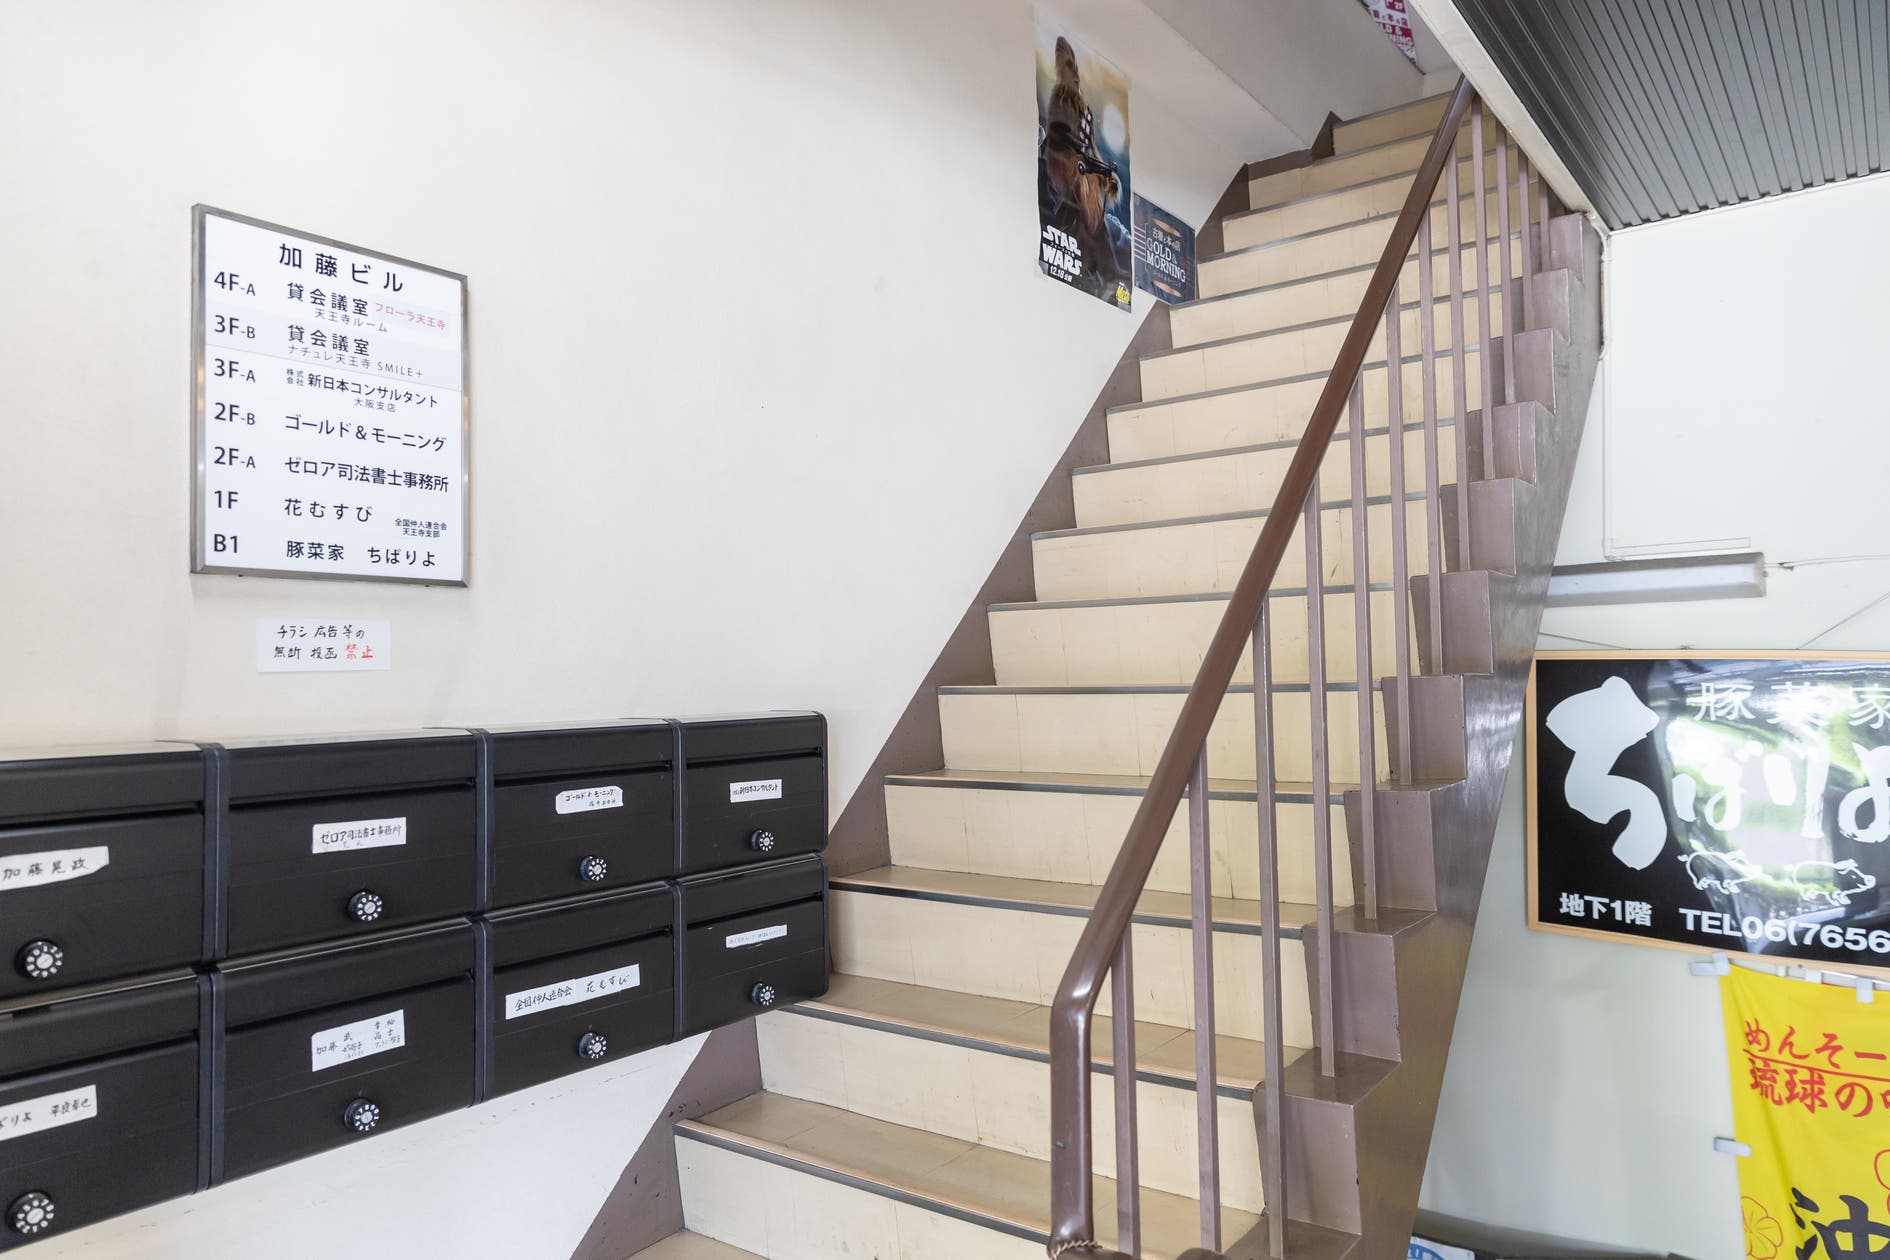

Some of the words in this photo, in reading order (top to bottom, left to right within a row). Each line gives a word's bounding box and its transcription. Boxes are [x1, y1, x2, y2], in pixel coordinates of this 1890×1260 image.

[1043, 224, 1081, 256] STAR
[1146, 237, 1171, 260] GOLD
[279, 243, 403, 292] 加藤ビル
[1042, 243, 1082, 275] WARS
[1146, 250, 1186, 283] MORNING
[214, 271, 256, 296] 4F-A
[287, 282, 368, 316] 貸会議室
[375, 302, 446, 330] フローラ天王寺
[214, 315, 256, 339] 3F-B
[315, 308, 388, 332] 天王寺ルーム
[288, 324, 369, 356] 貸会議室
[288, 344, 371, 369] ナチュレ天王寺
[214, 358, 256, 383] 3F-A
[307, 373, 438, 408] 新日本コンサルタント
[214, 402, 256, 426] 2F-B
[354, 398, 396, 413] 大阪支店
[214, 447, 256, 469] 2F-A
[284, 457, 449, 493] ゼロア司法書士事務所
[214, 491, 239, 509] 1F
[284, 498, 373, 523] 花むすび
[214, 534, 239, 553] B1
[286, 540, 345, 561] 豚菜家
[367, 547, 436, 568] ちばりよ
[345, 643, 374, 661] 禁止
[1559, 892, 1652, 927] 地下1階
[1743, 1017, 1888, 1070] めんそー
